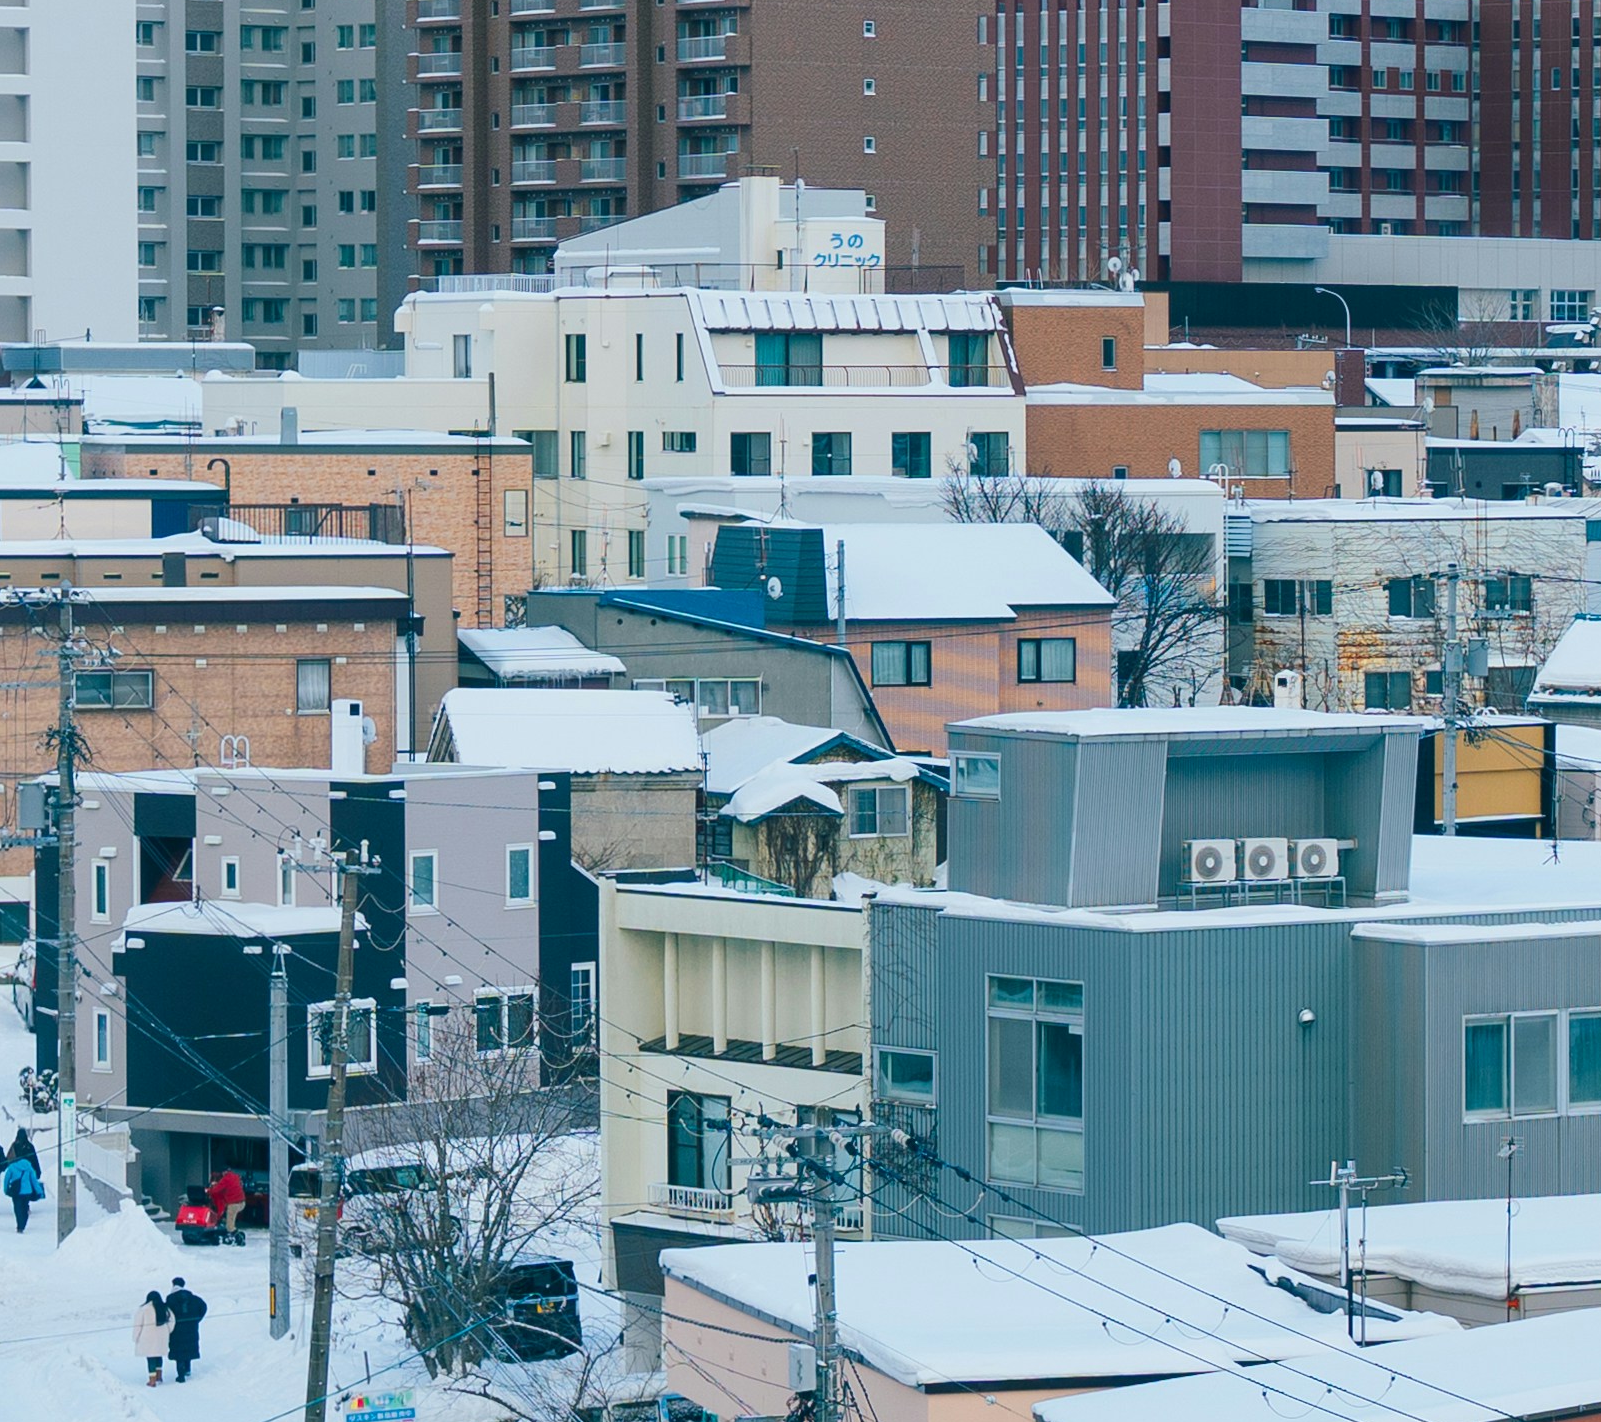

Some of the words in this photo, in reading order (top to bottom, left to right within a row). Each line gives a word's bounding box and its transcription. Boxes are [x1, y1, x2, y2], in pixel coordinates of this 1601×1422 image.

[830, 233, 864, 249] うの
[813, 253, 881, 268] クリニック
